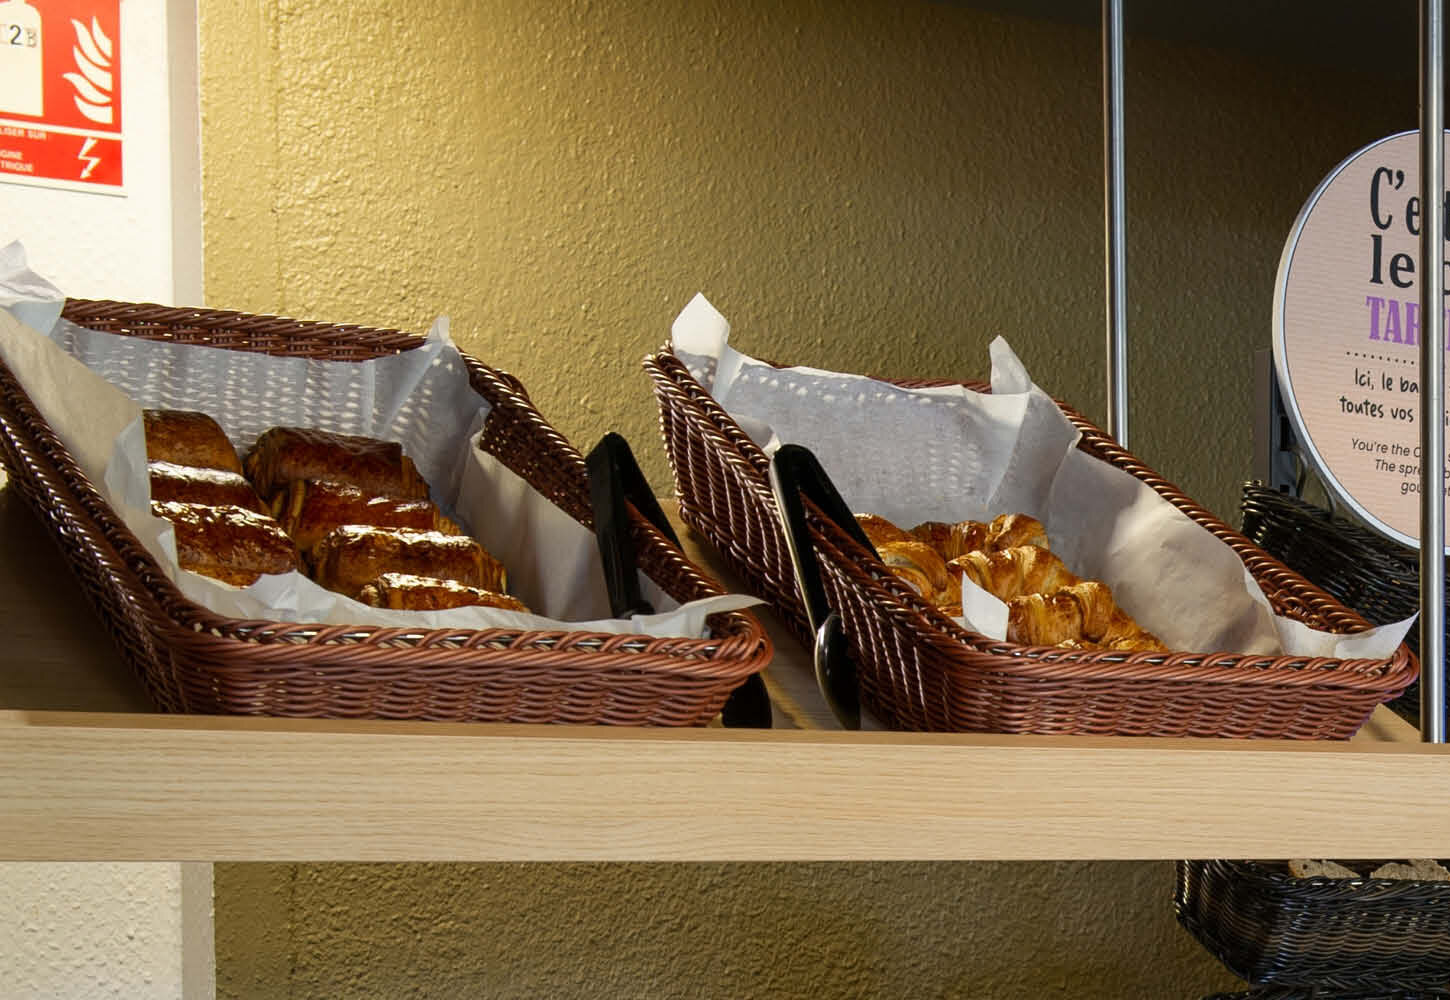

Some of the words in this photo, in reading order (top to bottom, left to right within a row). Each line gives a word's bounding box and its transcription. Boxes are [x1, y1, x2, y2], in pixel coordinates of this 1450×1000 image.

[1369, 233, 1416, 289] le
[1354, 367, 1375, 391] Ici,
[1381, 371, 1394, 392] le
[1338, 395, 1385, 419] toutes
[1390, 406, 1415, 423] vos
[1351, 438, 1389, 455] You're
[1391, 443, 1411, 457] the
[1375, 458, 1397, 473] The
